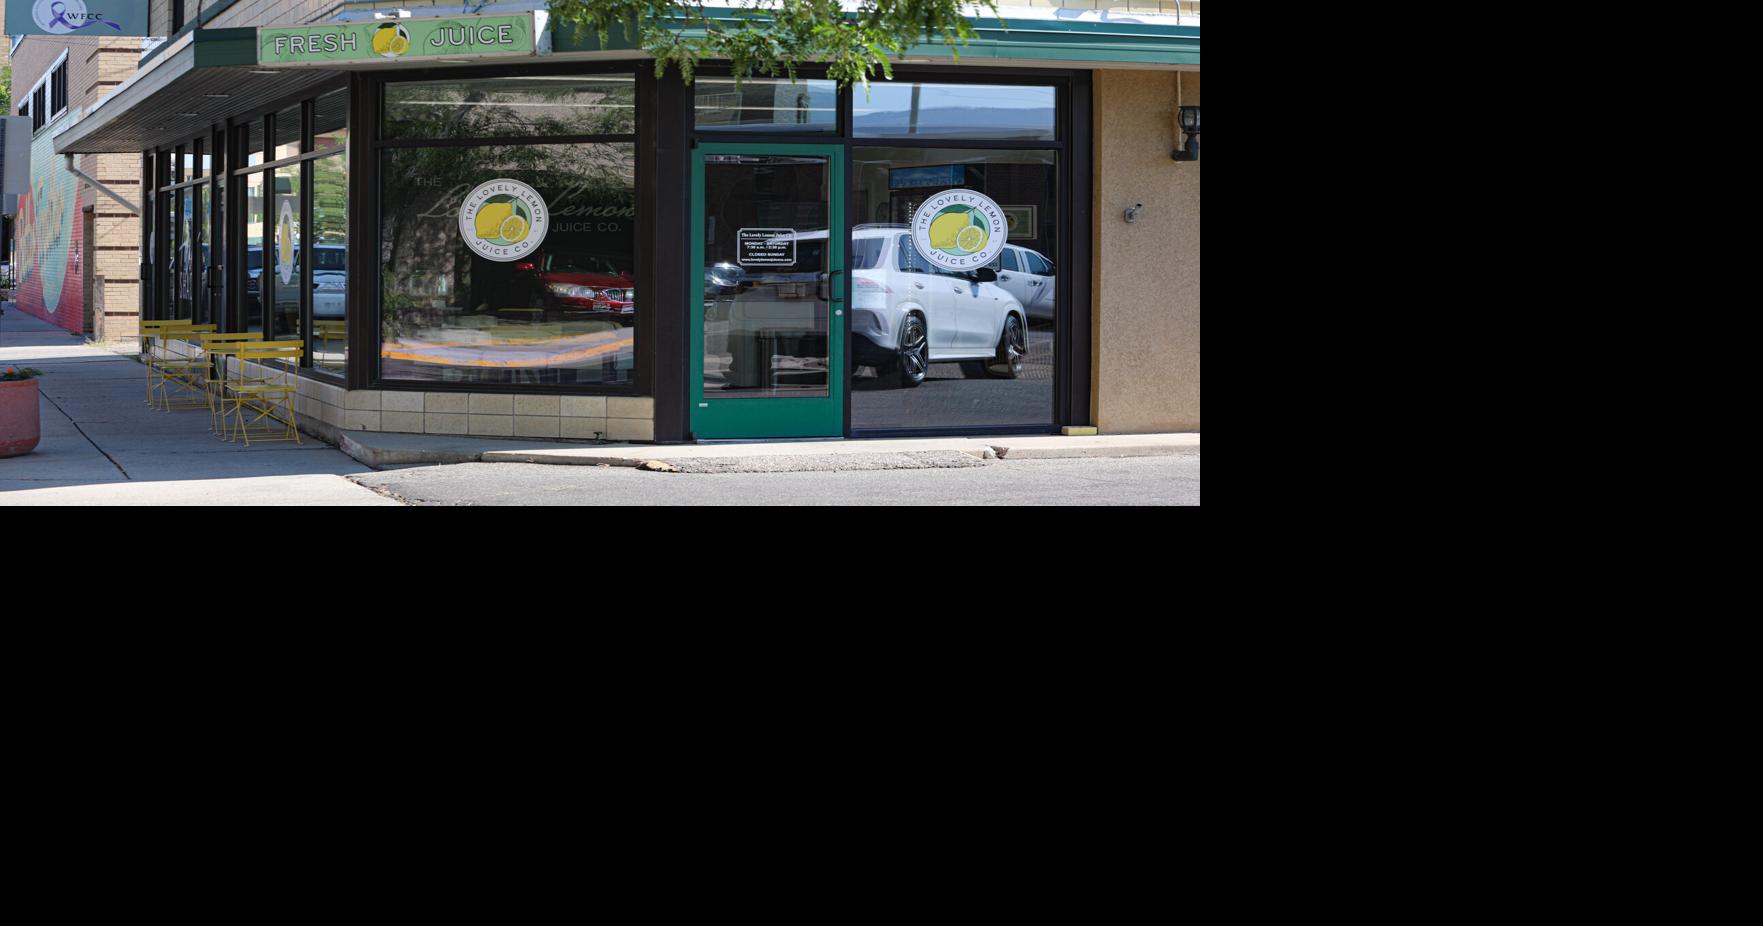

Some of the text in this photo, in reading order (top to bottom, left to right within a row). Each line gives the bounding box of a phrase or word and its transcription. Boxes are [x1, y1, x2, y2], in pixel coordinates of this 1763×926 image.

[274, 24, 513, 55] FRESH JUICE
[415, 177, 442, 187] THE
[465, 184, 542, 223] THE LOVELY LEMON
[919, 194, 1001, 233] THE LOVELY LEMON
[552, 222, 623, 233] JUICE CO.
[475, 240, 509, 256] JUICE
[930, 250, 966, 265] JUICE
